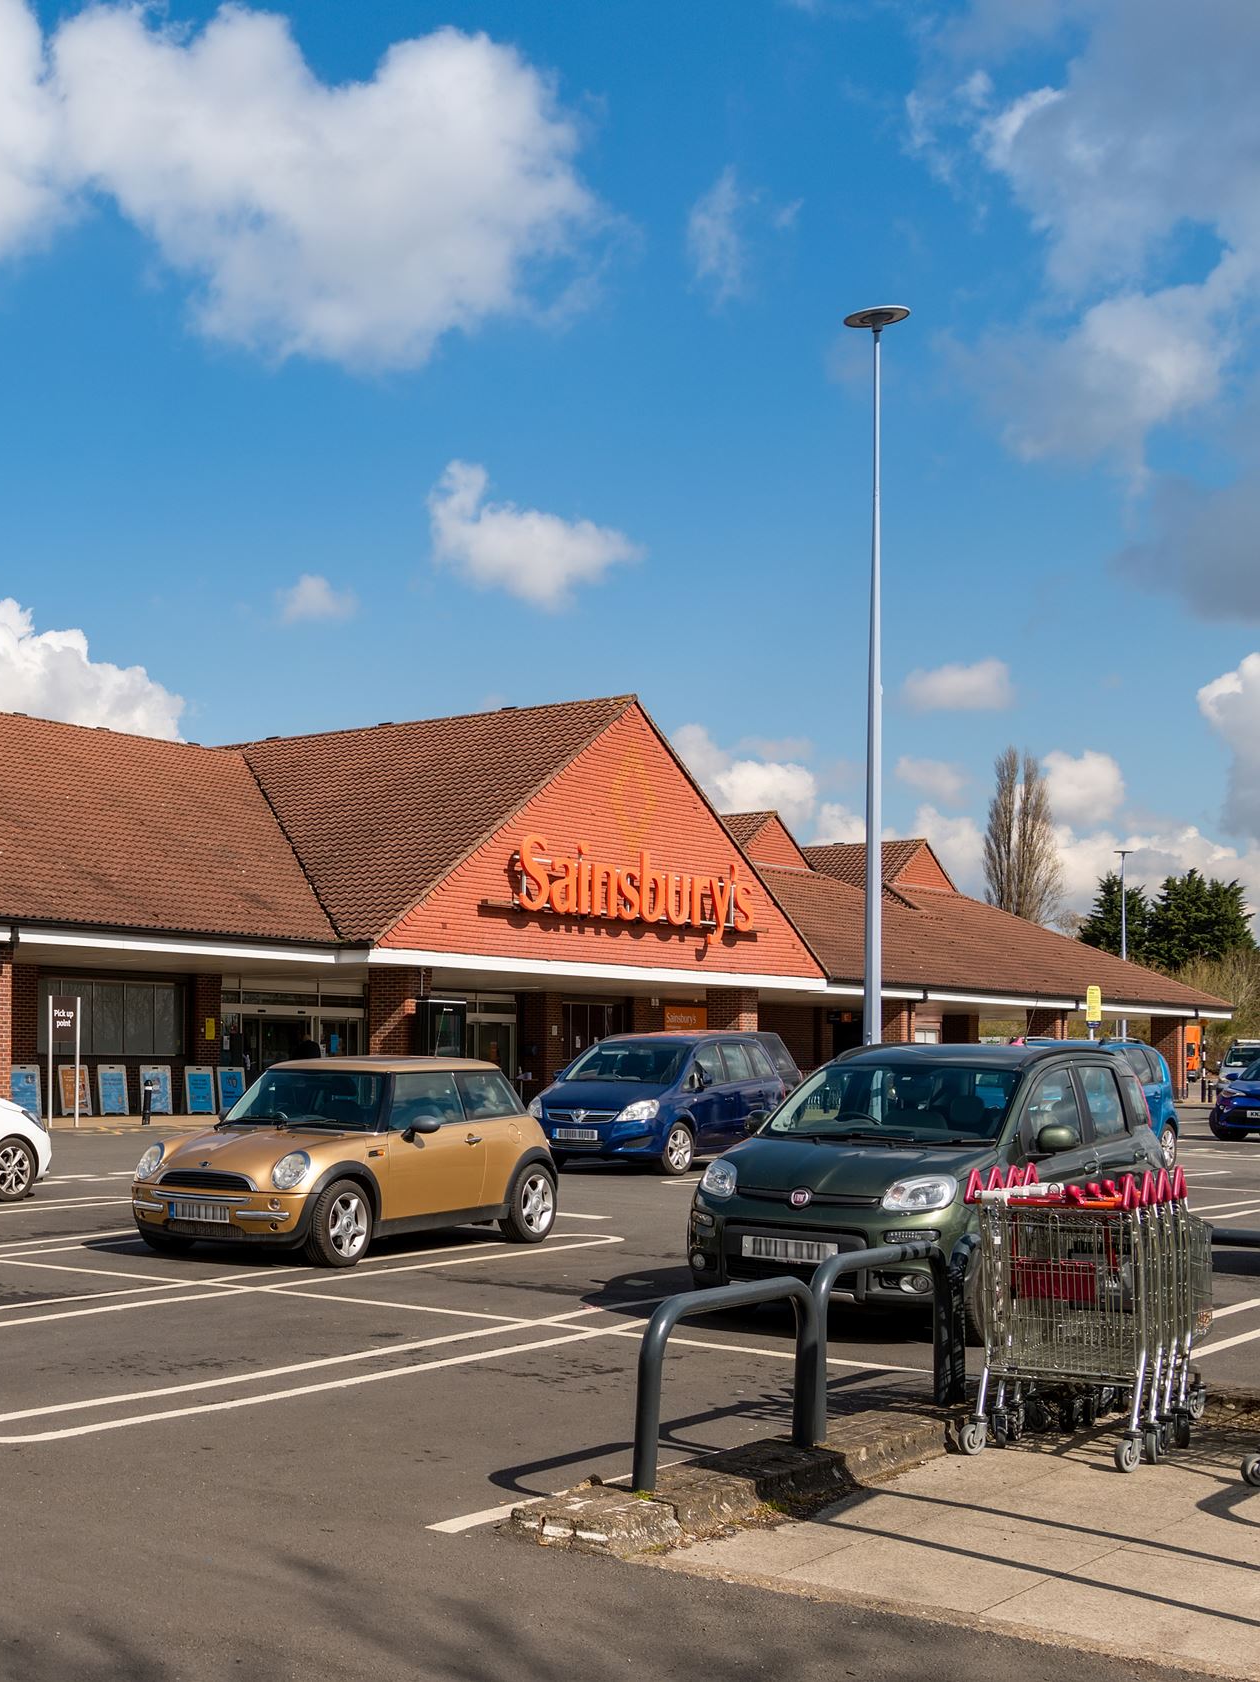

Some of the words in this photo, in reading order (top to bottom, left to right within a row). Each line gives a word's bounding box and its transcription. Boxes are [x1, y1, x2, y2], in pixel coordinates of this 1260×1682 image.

[519, 834, 754, 945] Sainsbury's
[53, 1008, 66, 1017] Pick
[66, 1011, 74, 1019] up
[666, 1012, 697, 1026] Sainsbury's
[56, 1019, 72, 1028] point
